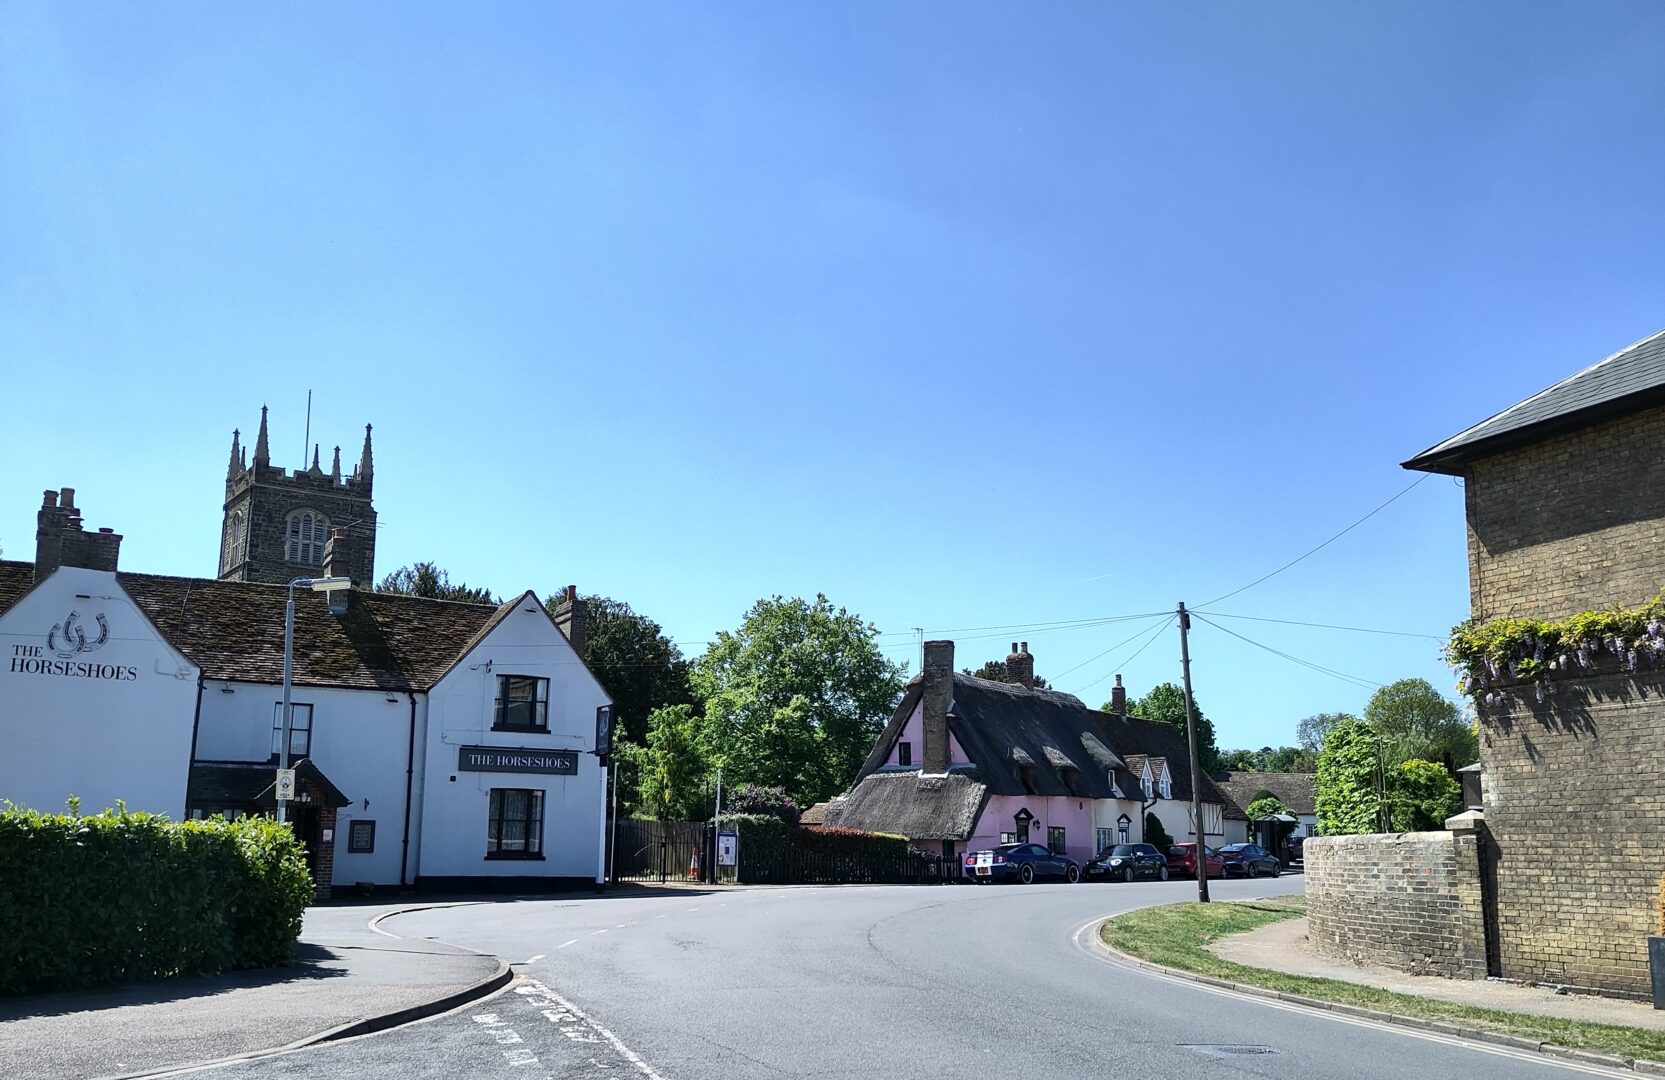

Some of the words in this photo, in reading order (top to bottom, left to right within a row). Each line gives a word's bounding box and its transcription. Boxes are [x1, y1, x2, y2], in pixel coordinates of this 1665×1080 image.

[12, 644, 44, 658] THE
[9, 658, 137, 682] HORSESHOES
[469, 754, 494, 766] THE
[496, 755, 571, 769] HORSESHOES
